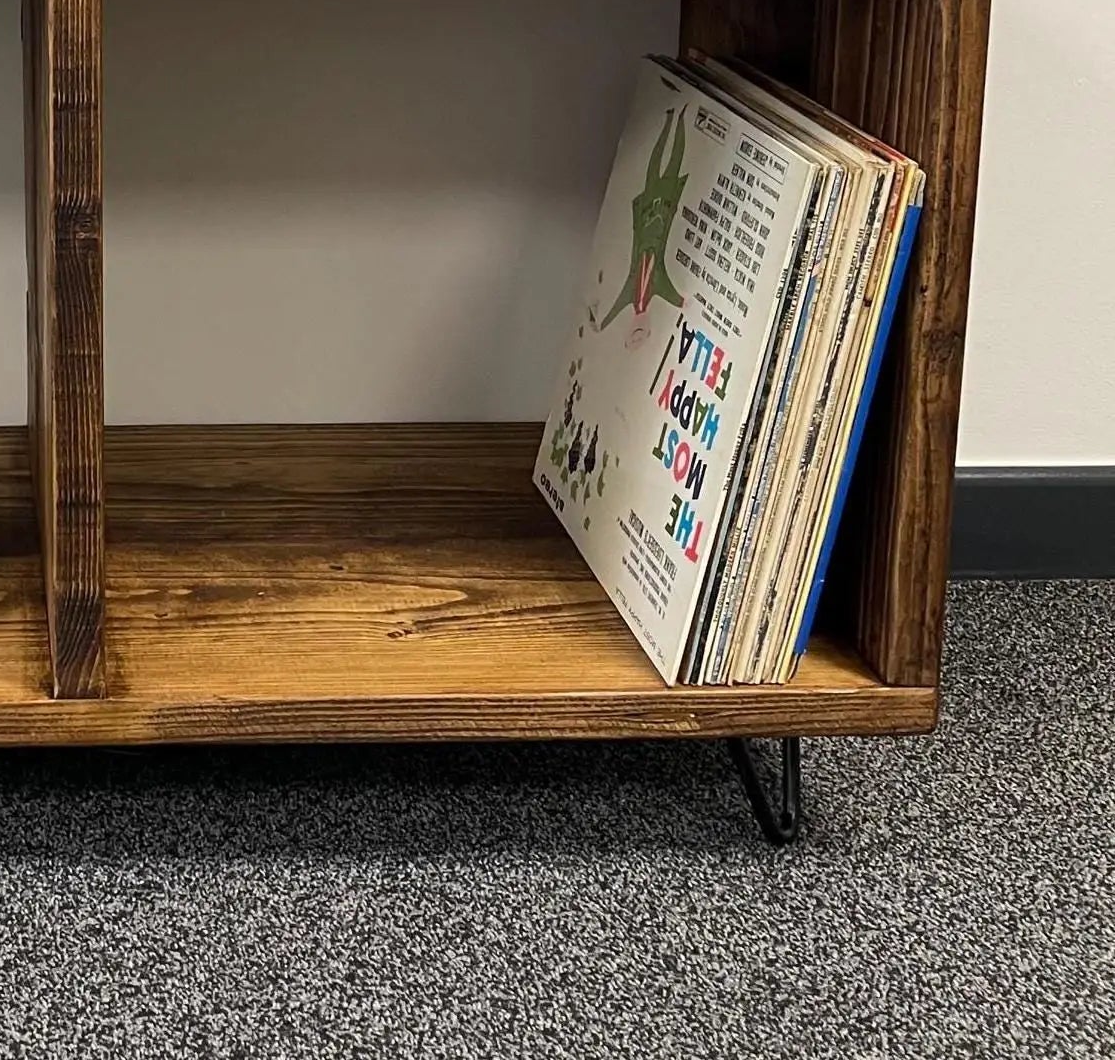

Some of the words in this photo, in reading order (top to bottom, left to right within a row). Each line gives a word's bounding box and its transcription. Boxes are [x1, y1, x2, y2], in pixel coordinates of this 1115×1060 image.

[657, 367, 720, 452] HAPPY
[540, 473, 564, 513] stereo
[651, 421, 707, 499] MOST
[664, 491, 703, 566] THE
